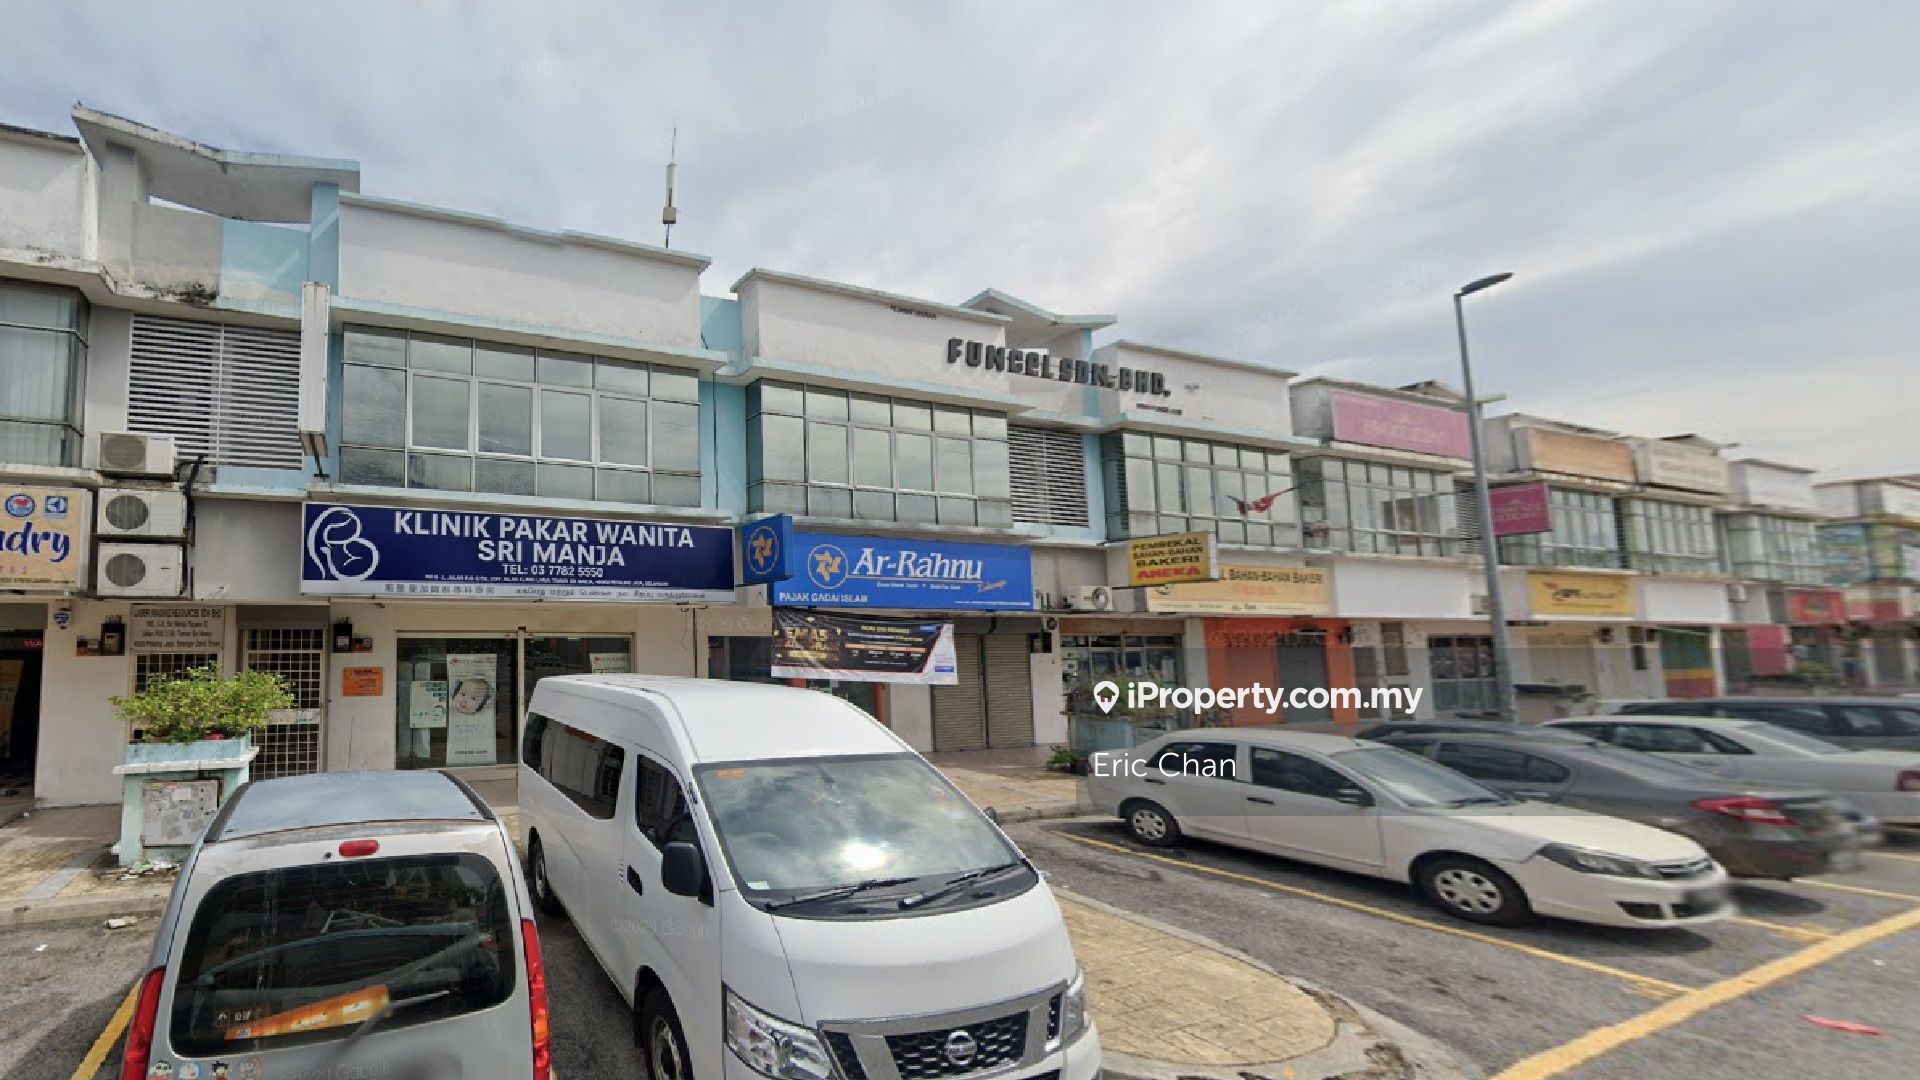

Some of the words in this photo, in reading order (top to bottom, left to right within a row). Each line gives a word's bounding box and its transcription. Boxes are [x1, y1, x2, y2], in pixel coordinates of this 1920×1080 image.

[394, 510, 492, 538] KLINIK
[499, 516, 588, 544] PAKAR
[594, 522, 695, 549] WANITA
[477, 539, 524, 563] SRI
[533, 541, 626, 567] MANJA
[1136, 555, 1200, 567] BAKERI
[502, 564, 529, 576] TEL:
[531, 564, 546, 576] 03
[850, 547, 983, 580] Ar-Rahnu
[779, 591, 810, 602] PAJAK
